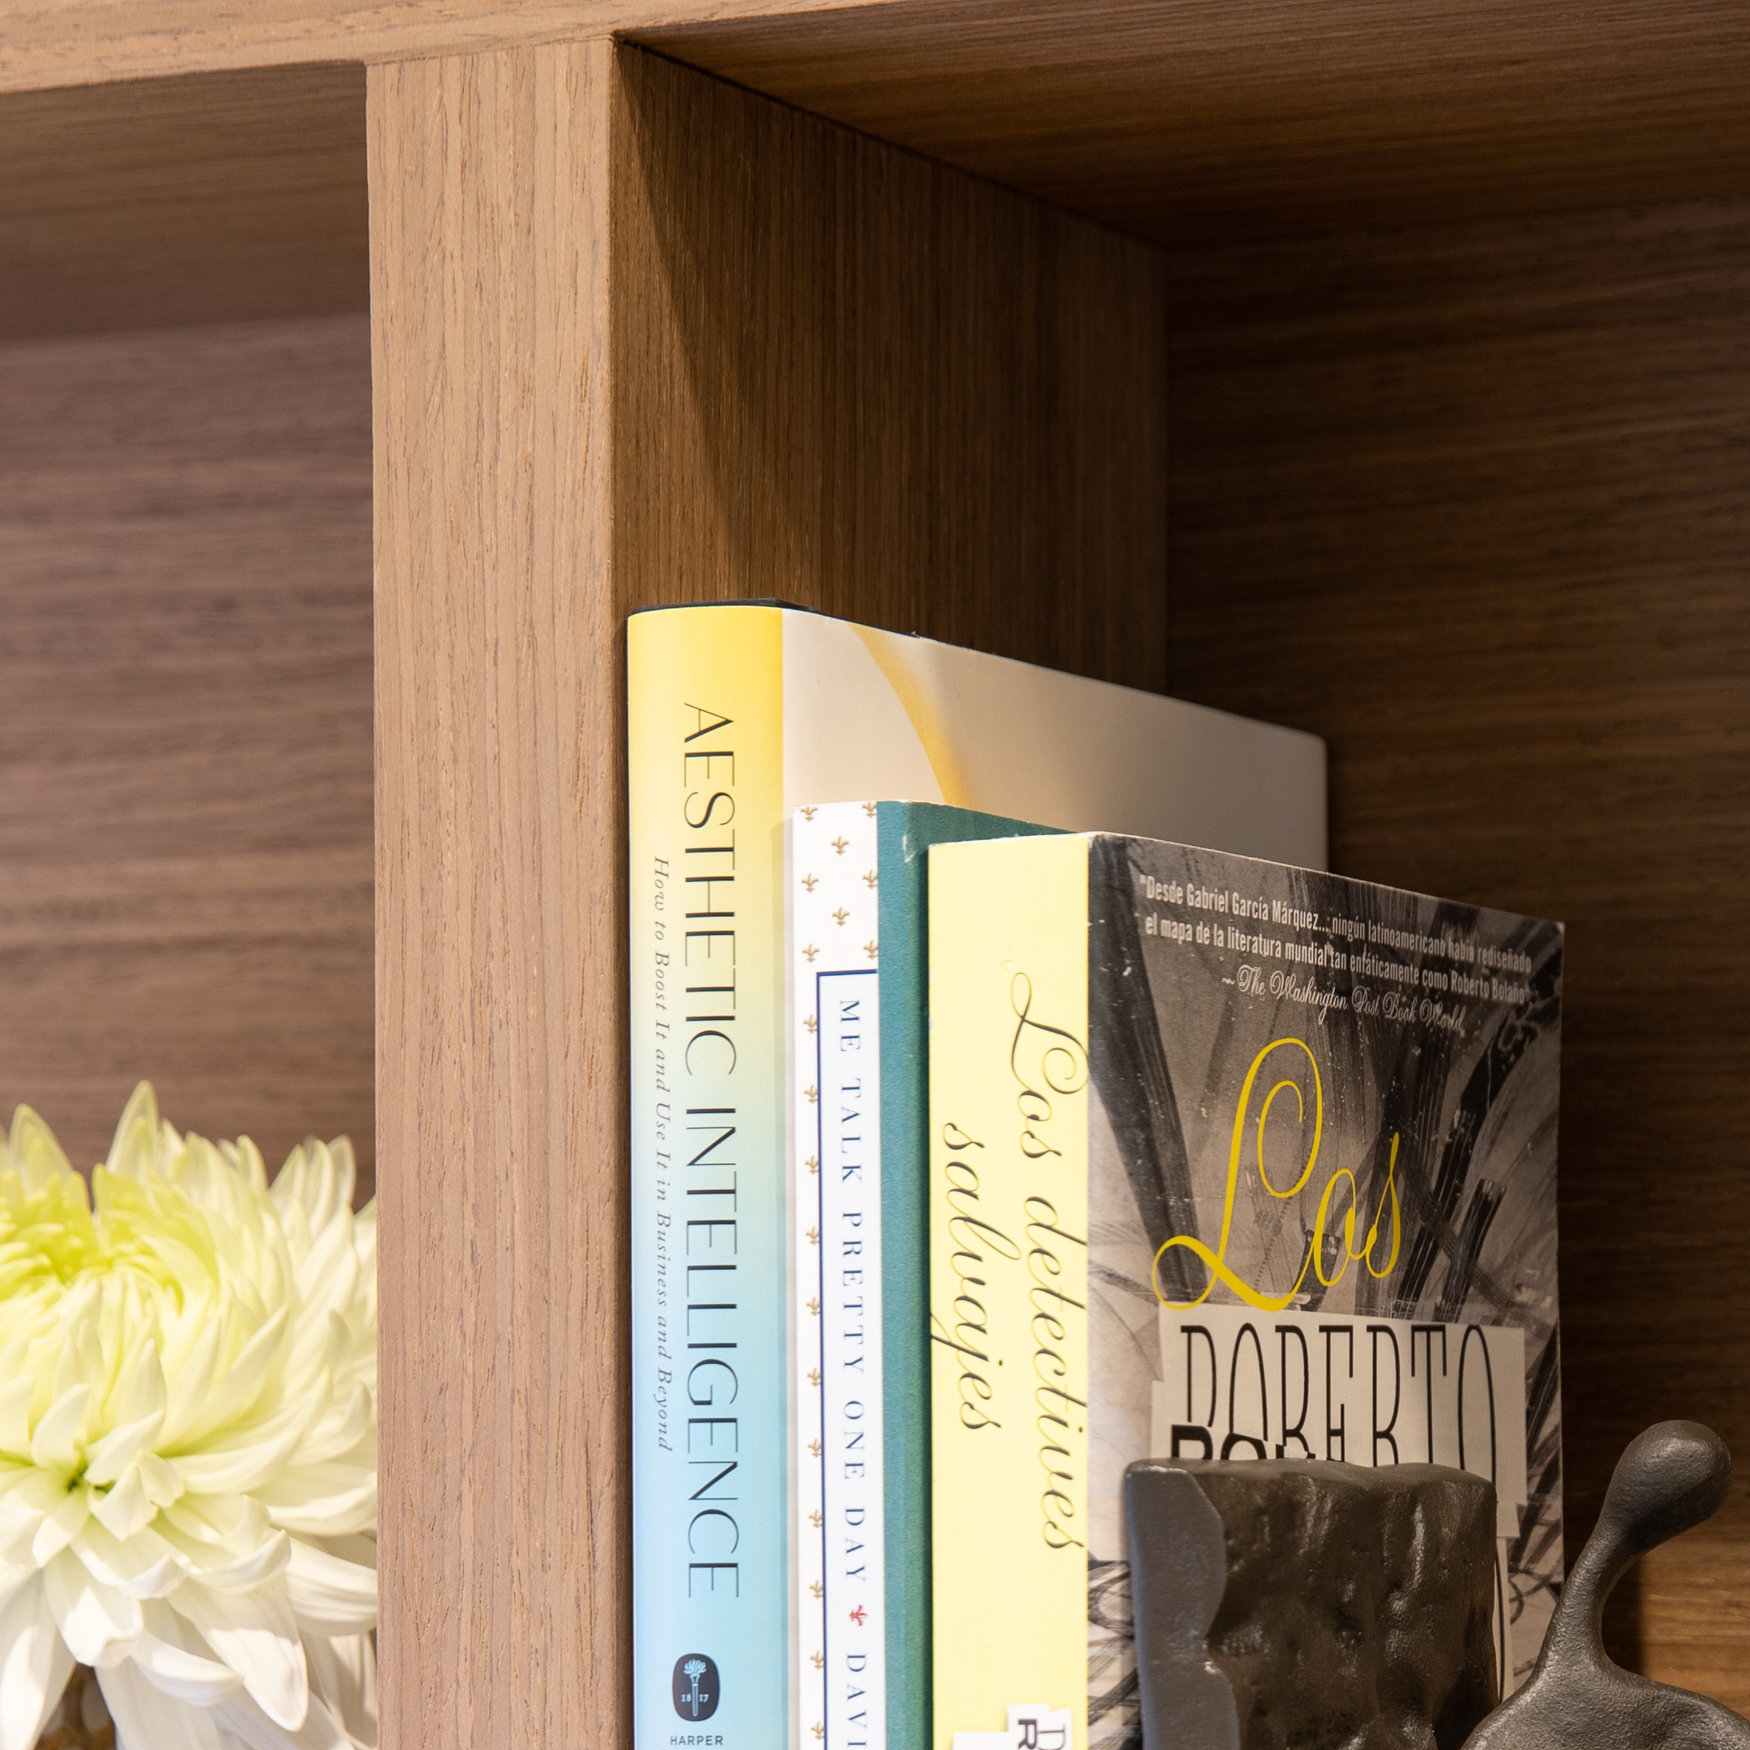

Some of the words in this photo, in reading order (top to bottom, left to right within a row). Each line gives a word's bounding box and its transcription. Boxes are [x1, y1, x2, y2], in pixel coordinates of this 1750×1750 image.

[654, 856, 670, 912] How
[683, 702, 738, 1077] AESTHETIC
[654, 919, 668, 941] to
[1144, 911, 1158, 936] el
[1160, 918, 1194, 945] mapa
[1195, 920, 1211, 945] de
[1213, 923, 1225, 948] la
[1227, 926, 1282, 958] literatura
[1284, 941, 1327, 969] mundial
[1330, 948, 1347, 971] tan
[1350, 944, 1420, 985] enfáticamente
[1421, 967, 1449, 991] como
[1451, 968, 1490, 999] Roberto
[1186, 882, 1229, 914] Gabriel
[1231, 891, 1269, 921] García
[1332, 912, 1366, 942] ningún
[1368, 919, 1446, 957] latinoamericano
[1448, 935, 1475, 964] había
[1477, 943, 1532, 974] rediseñado
[655, 950, 671, 1012] Boost
[1236, 963, 1267, 996] The
[1269, 969, 1349, 1025] Washington
[1350, 984, 1380, 1016] Post
[1382, 990, 1417, 1024] Book
[655, 1019, 671, 1041] It
[839, 1000, 863, 1053] ME
[1010, 971, 1089, 1159] Las
[655, 1048, 671, 1093] and
[656, 1102, 672, 1141] Use
[656, 1148, 672, 1170] It
[840, 1077, 864, 1184] TALK
[656, 1178, 672, 1202] in
[1151, 1037, 1402, 1312] Las
[656, 1210, 672, 1308] Business
[841, 1211, 866, 1374] PRETTY
[930, 1122, 1022, 1430] salvajes
[656, 1315, 673, 1361] and
[685, 1107, 740, 1598] INTELLIGENCE
[1024, 1195, 1089, 1550] detectives
[653, 1367, 673, 1453] Beyond
[843, 1400, 867, 1480] ONE
[844, 1507, 868, 1582] DAY
[670, 1735, 724, 1746] HARPER
